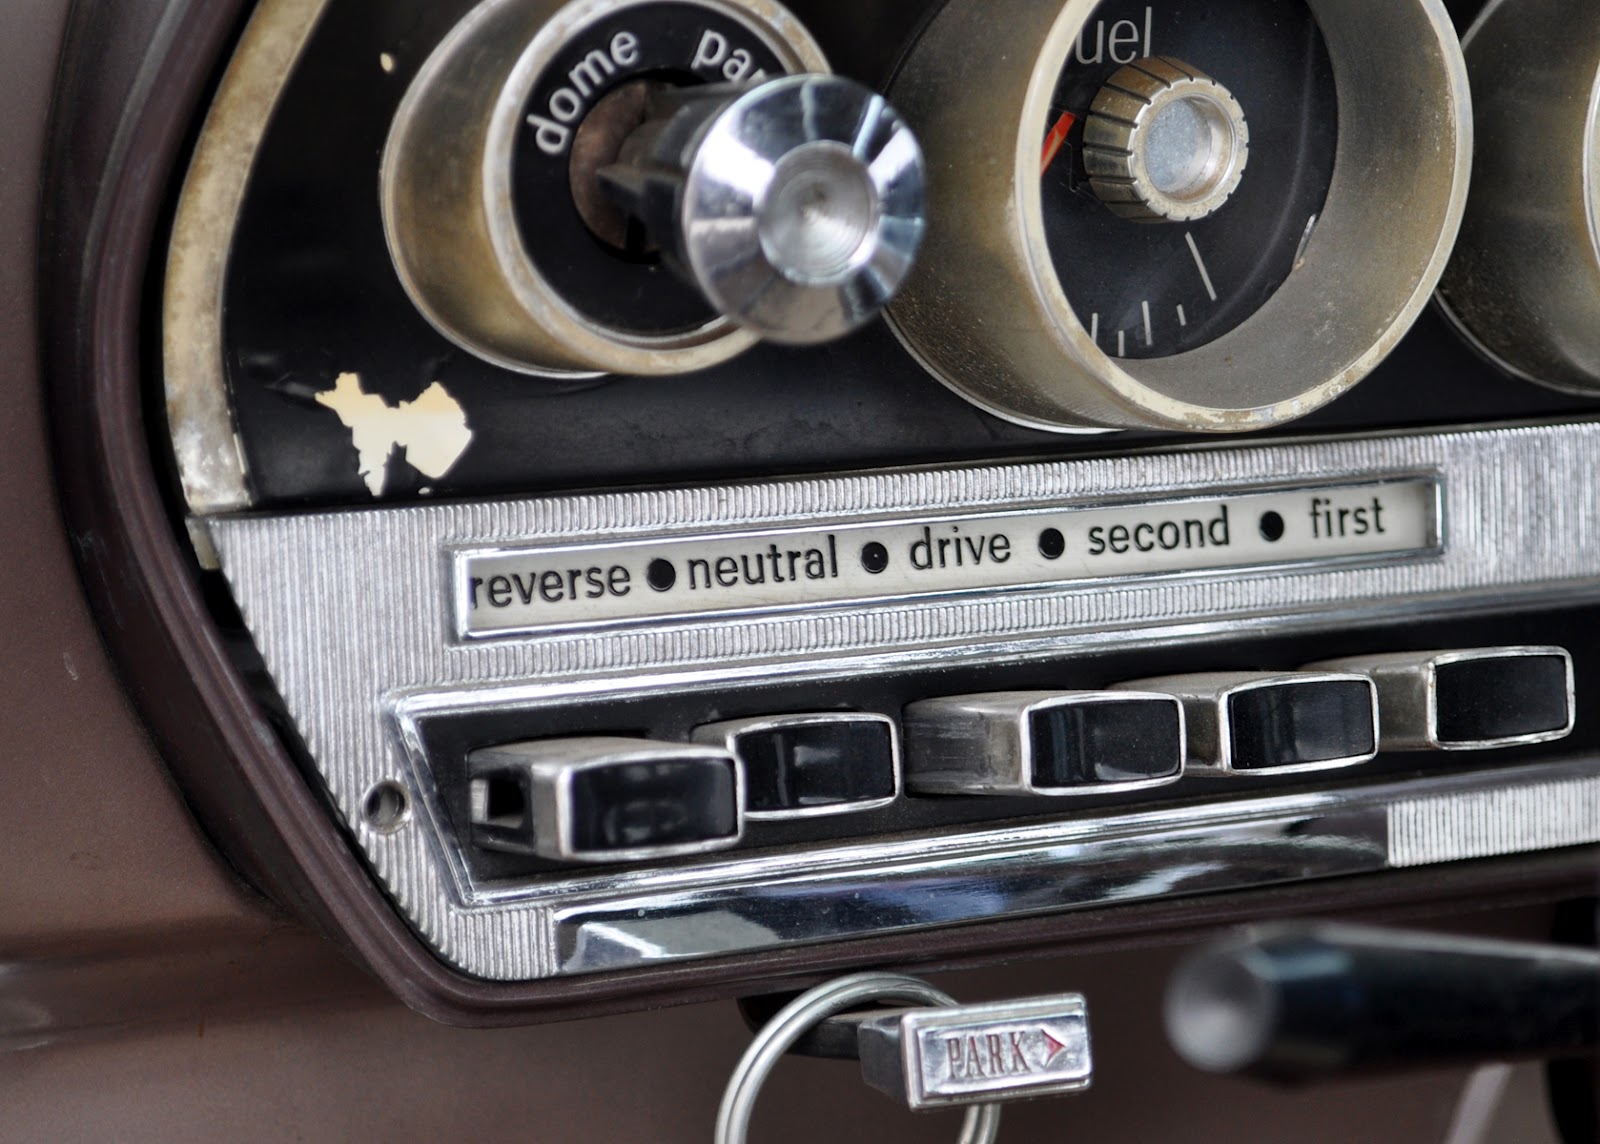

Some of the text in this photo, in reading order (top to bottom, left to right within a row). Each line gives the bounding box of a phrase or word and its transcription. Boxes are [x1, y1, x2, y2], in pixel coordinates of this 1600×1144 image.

[1075, 6, 1152, 65] uel
[526, 30, 640, 156] dome
[470, 497, 1386, 609] reverse neutral drive second first
[945, 1031, 1032, 1080] PARK
